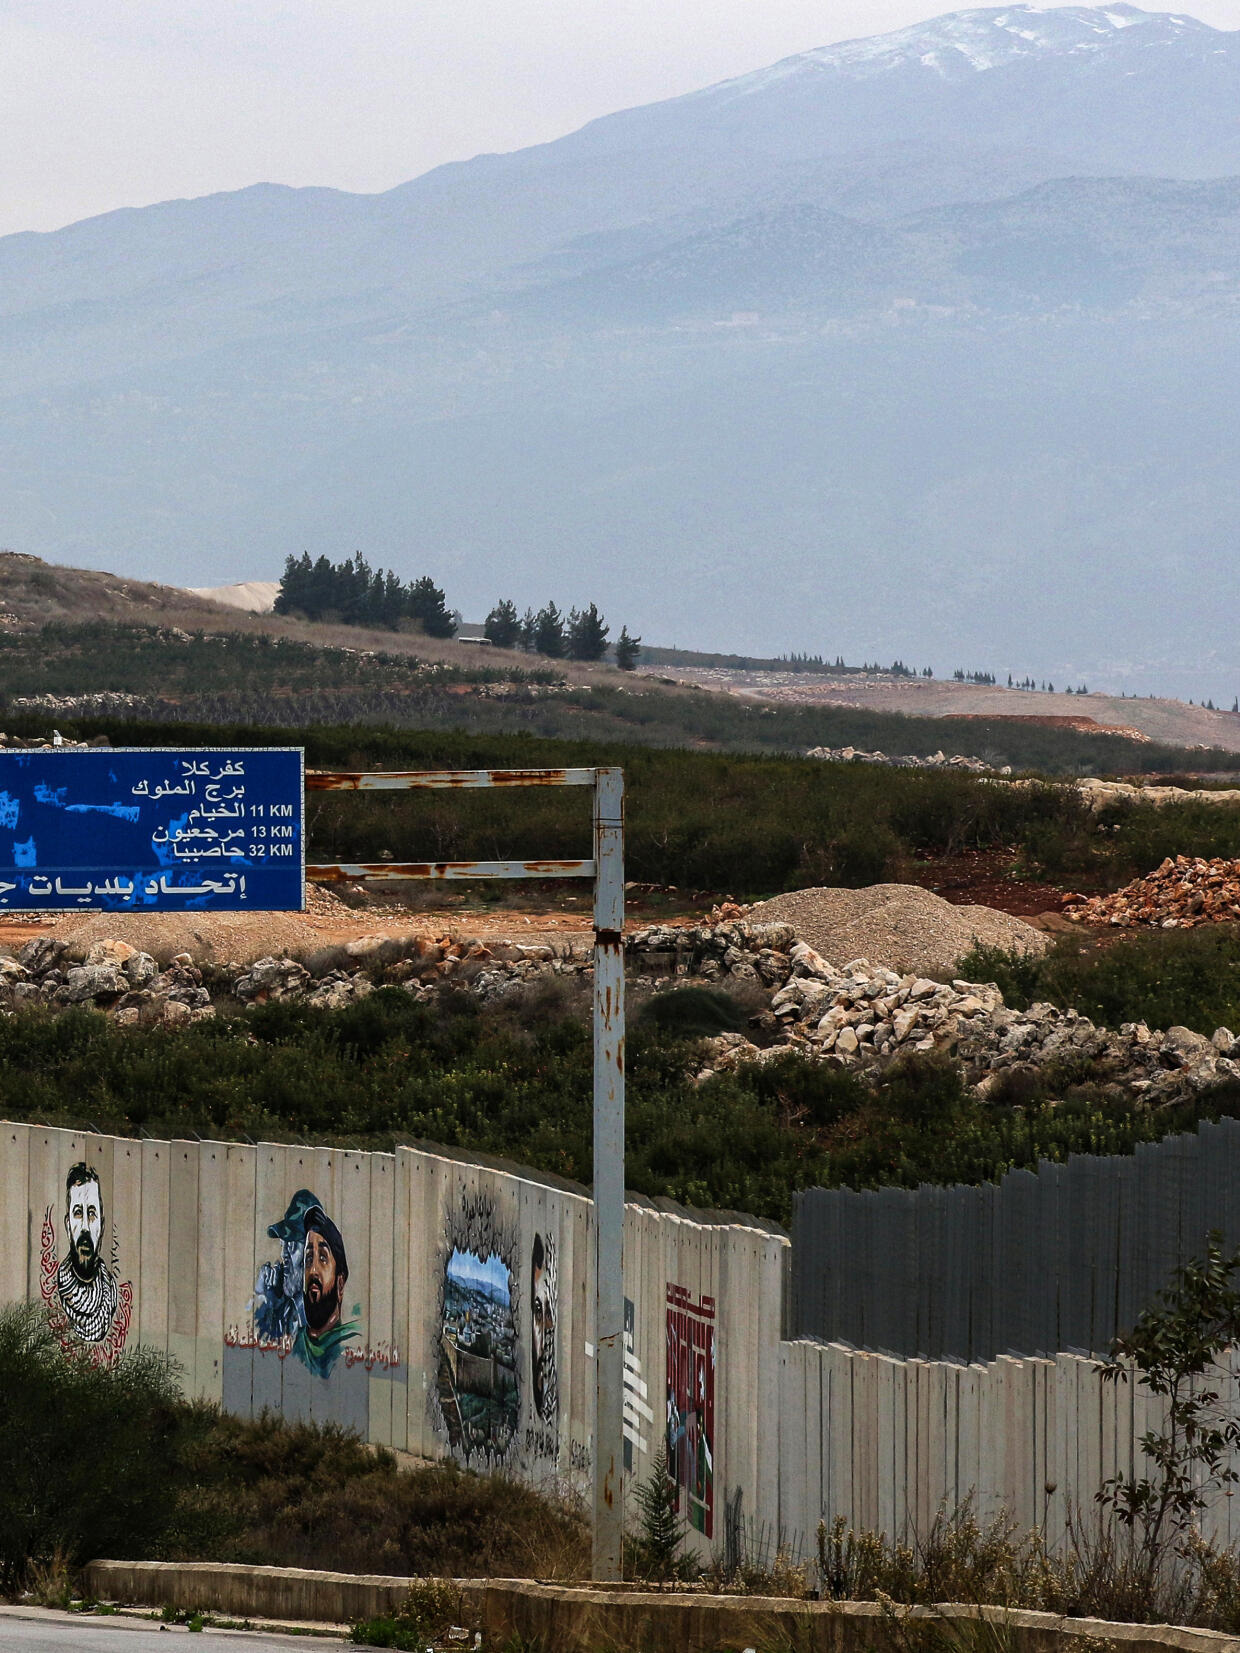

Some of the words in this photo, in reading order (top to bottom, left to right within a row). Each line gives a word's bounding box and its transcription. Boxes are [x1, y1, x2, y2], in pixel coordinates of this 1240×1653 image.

[131, 780, 195, 799] الملوك
[205, 784, 245, 801] برج
[189, 802, 245, 824] الخيام
[250, 804, 264, 817] 11
[270, 804, 293, 817] KM
[152, 825, 245, 842] مرجعيون
[251, 826, 267, 838] 13
[271, 826, 293, 838] KM
[173, 842, 245, 863] حاصبيا
[249, 844, 265, 857] 32
[270, 844, 293, 857] KM
[28, 875, 134, 903] بلديات
[144, 872, 247, 899] إتحاد
